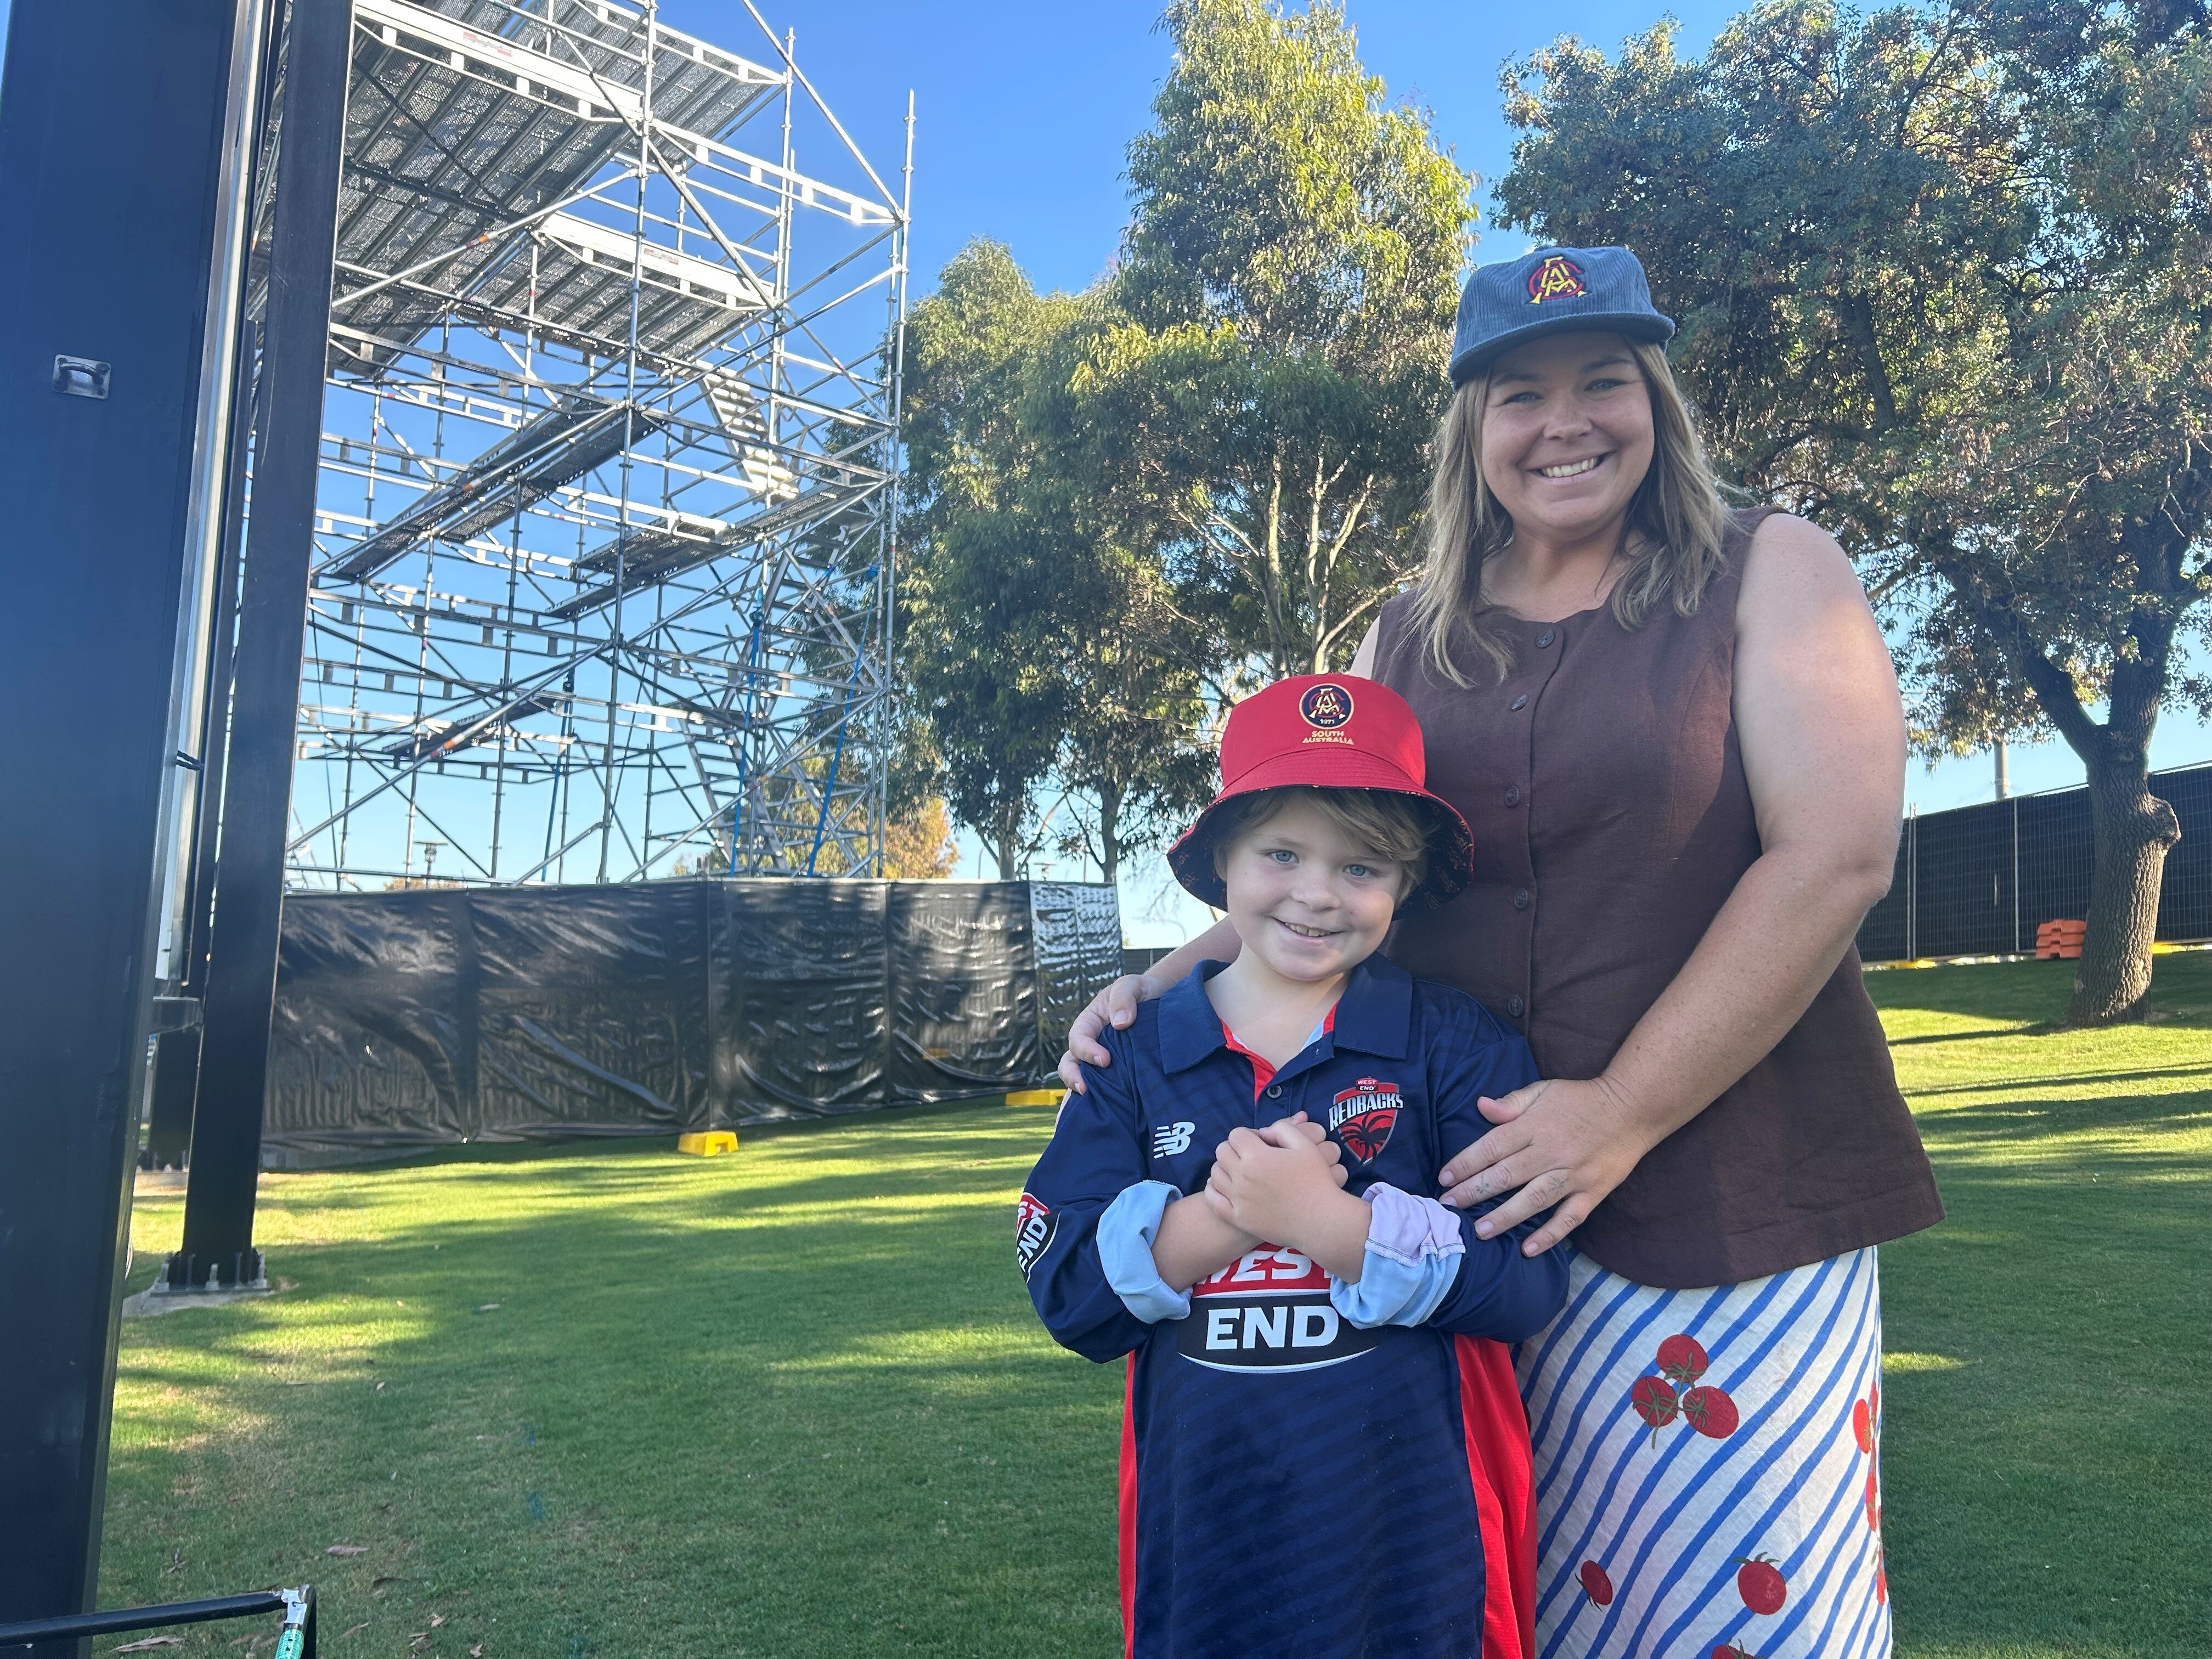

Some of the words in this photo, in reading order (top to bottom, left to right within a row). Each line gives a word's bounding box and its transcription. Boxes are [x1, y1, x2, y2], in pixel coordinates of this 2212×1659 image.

[1301, 737, 1354, 746] AUSTRALIA
[1328, 1092, 1404, 1132] REDBACKS
[1017, 1217, 1048, 1273] END
[1197, 1246, 1333, 1285] ES
[1205, 1305, 1339, 1350] END
